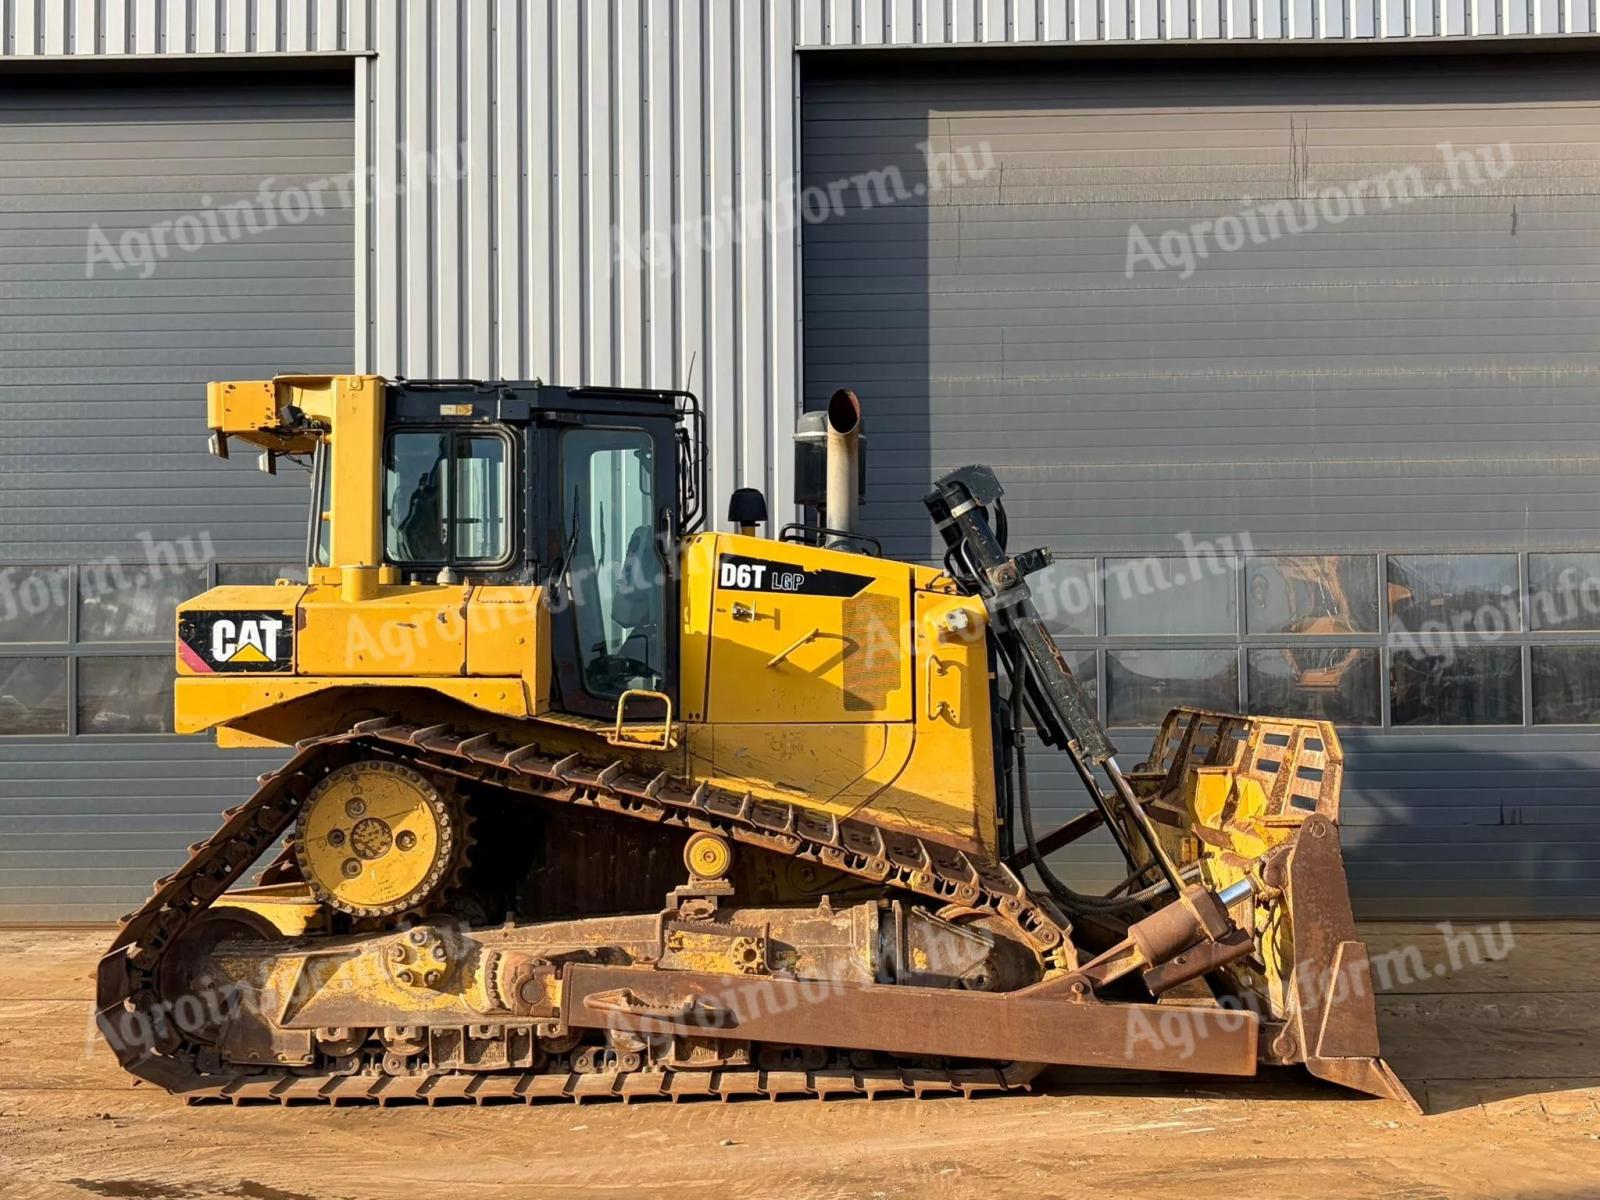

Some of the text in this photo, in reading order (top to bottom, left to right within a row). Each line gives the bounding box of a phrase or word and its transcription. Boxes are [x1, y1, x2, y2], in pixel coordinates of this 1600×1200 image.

[720, 563, 805, 591] D6T LGP
[212, 619, 283, 662] CAT
